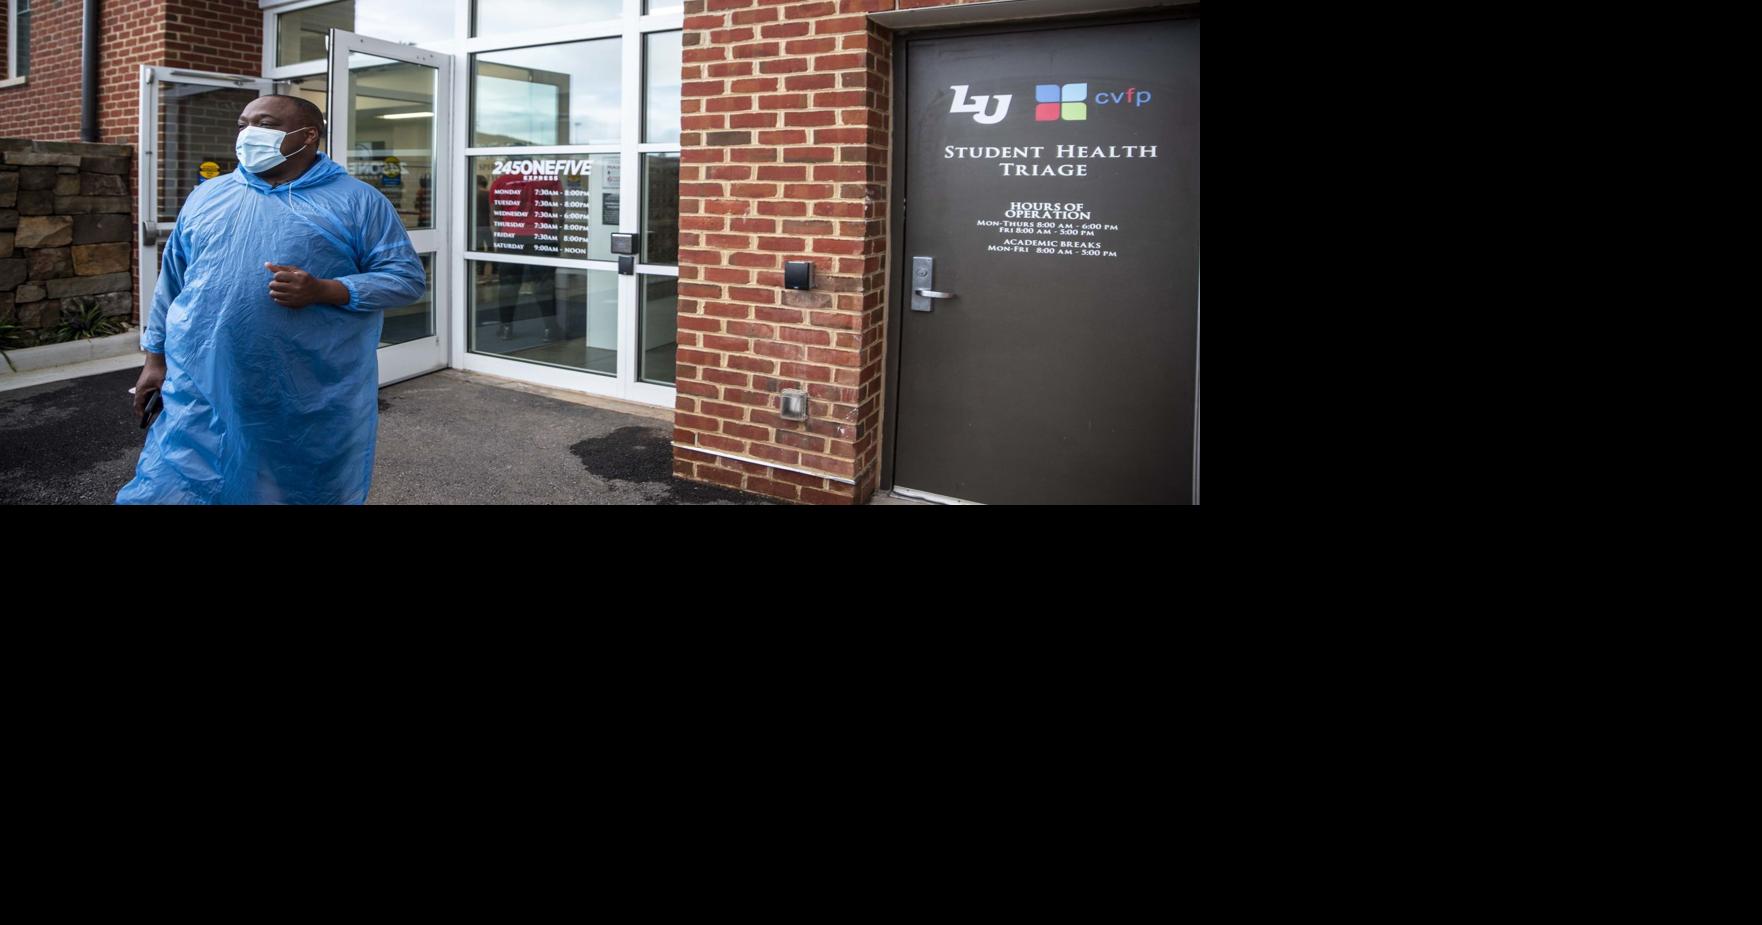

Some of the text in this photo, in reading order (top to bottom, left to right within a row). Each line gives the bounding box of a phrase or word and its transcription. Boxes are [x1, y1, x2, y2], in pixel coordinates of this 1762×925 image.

[1095, 88, 1152, 107] cvfp
[1010, 202, 1084, 212] HOURS OF
[493, 210, 529, 218] WEDNESDAY
[1004, 210, 1091, 220] OPERATION
[494, 221, 525, 229] THURSDAY
[1036, 221, 1056, 229] 8:00
[493, 242, 525, 250] SATURDAY
[1003, 238, 1101, 249] ACADEMIC BREAKS
